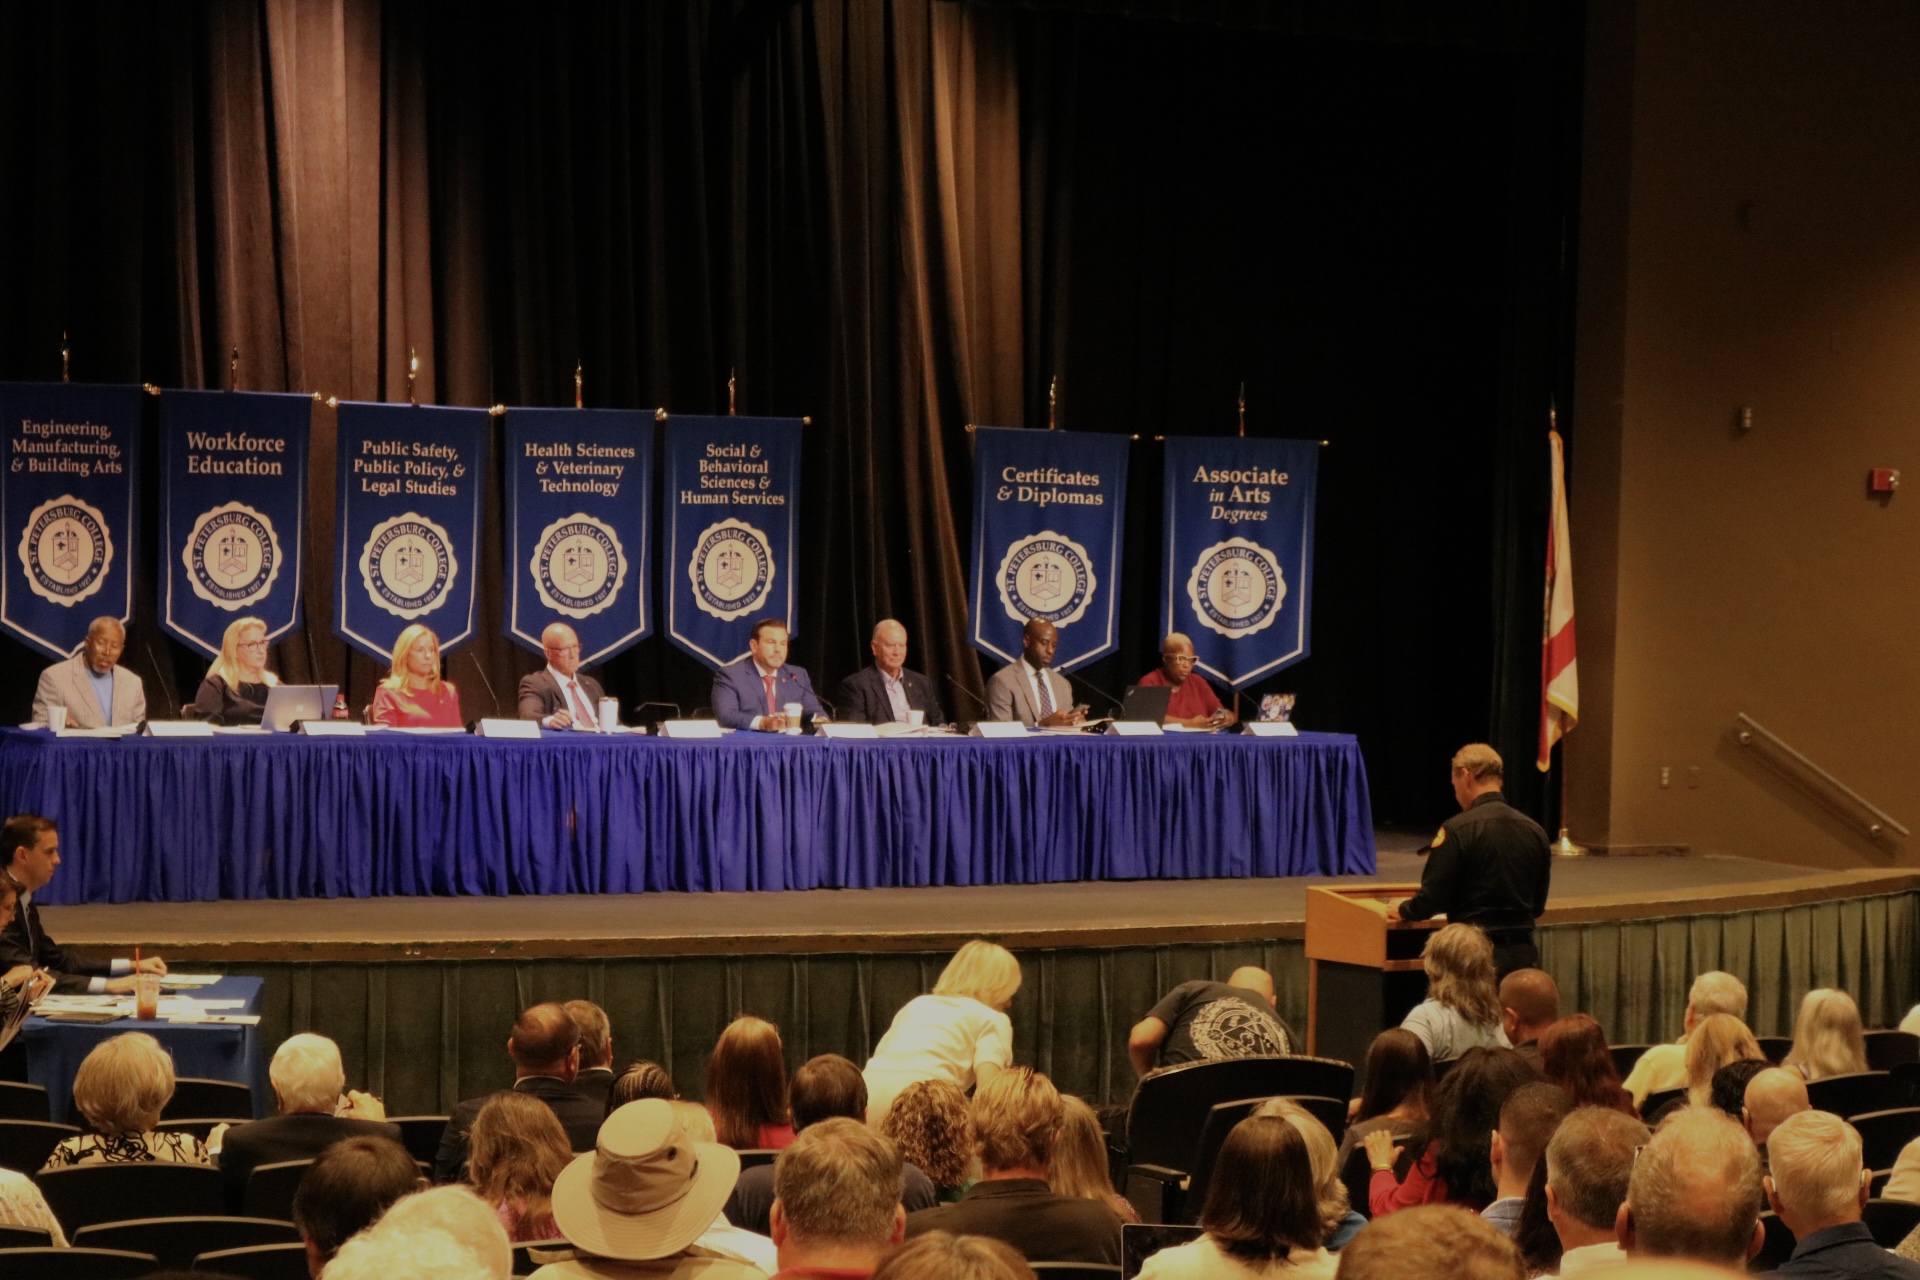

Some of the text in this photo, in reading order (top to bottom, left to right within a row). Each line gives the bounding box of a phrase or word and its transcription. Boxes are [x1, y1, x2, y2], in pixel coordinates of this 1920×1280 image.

[22, 419, 112, 440] Engineering,
[12, 439, 121, 458] Manufacturing,
[187, 431, 285, 452] Workforce
[525, 443, 635, 458] Health Sciences
[707, 443, 762, 458] Social &
[362, 441, 458, 462] Public Safety,
[11, 458, 122, 477] & Building Arts
[188, 456, 282, 475] Education
[354, 459, 465, 480] Public Policy, &
[536, 461, 624, 479] & Veterinary
[699, 459, 768, 473] Behavioral
[1193, 465, 1288, 485] Associate
[701, 476, 771, 489] Sciences &
[1002, 467, 1100, 486] Certificates
[362, 478, 456, 496] Legal Studies
[539, 479, 619, 496] Technology
[997, 486, 1103, 507] & Diplomas
[1209, 485, 1270, 503] in Arts
[681, 491, 784, 505] Human Services
[1211, 507, 1268, 524] Degrees
[30, 507, 81, 544] PETERSBURG
[82, 515, 103, 563] COLLEGE
[194, 513, 271, 569] ST. PETERSBURG COLLEGE
[371, 524, 447, 579] ST. PETERSBURG COLLEGE
[540, 525, 617, 578] ST. PETERSBURG COLLEGE
[698, 530, 745, 564] PETERSBURG
[746, 537, 767, 582] COLLEGE
[1007, 542, 1086, 595] ST. PETERSBURG COLLEGE
[1199, 548, 1277, 600] ST. PETERSBURG COLLEGE
[40, 574, 91, 594] ESTABLISHED 1927
[206, 581, 261, 599] ESTABLISHED 1927
[382, 588, 437, 608] ESTABLISHED 1927
[551, 589, 608, 607] ESTABLISHED 1927
[704, 592, 756, 610] ESTABLISHED 1927
[1060, 605, 1074, 617] 1927
[1209, 609, 1265, 628] ESTABLISHED 1927
